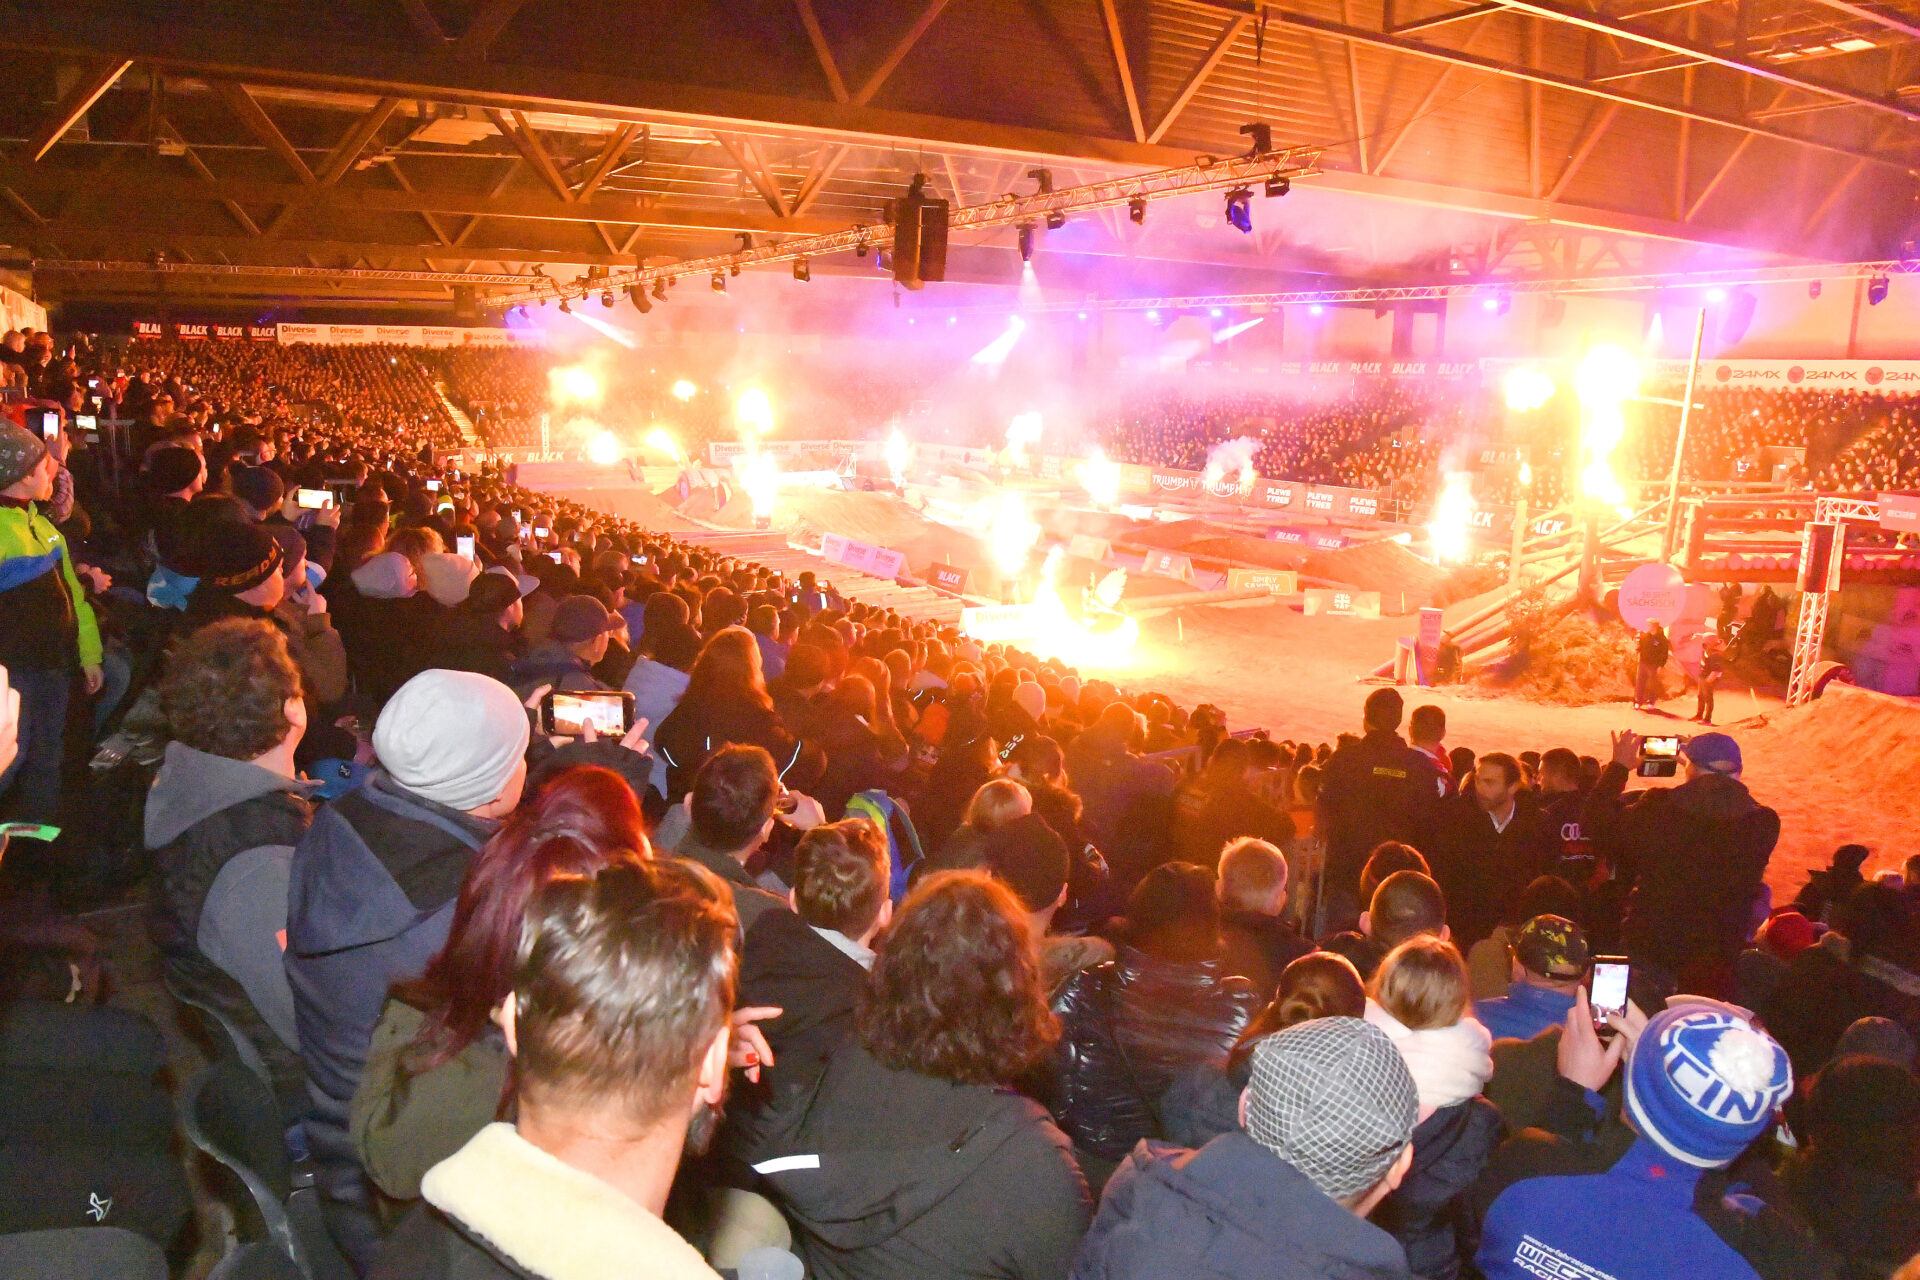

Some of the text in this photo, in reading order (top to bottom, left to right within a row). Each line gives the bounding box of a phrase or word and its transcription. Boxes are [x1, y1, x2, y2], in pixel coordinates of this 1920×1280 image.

[180, 324, 208, 335] BLACK
[217, 325, 243, 337] BLACK
[251, 327, 275, 337] BLACK
[281, 325, 317, 334] Diverse
[329, 326, 364, 335] Diverse
[376, 327, 410, 335] Diverse
[422, 327, 455, 336] Diverse
[1310, 362, 1339, 373] BLACK
[1350, 362, 1382, 374] BLACK
[1392, 362, 1426, 374] BLACK
[1656, 361, 1703, 374] Divere
[1732, 369, 1781, 380] 24MX
[1806, 369, 1858, 381] 24MX
[527, 452, 564, 463] BLACK
[1152, 474, 1189, 488] TRIUMPH
[1277, 531, 1301, 542] BLACK
[1318, 537, 1342, 548] BLACK
[1799, 530, 1812, 575] BLACK
[938, 570, 961, 585] BLACK
